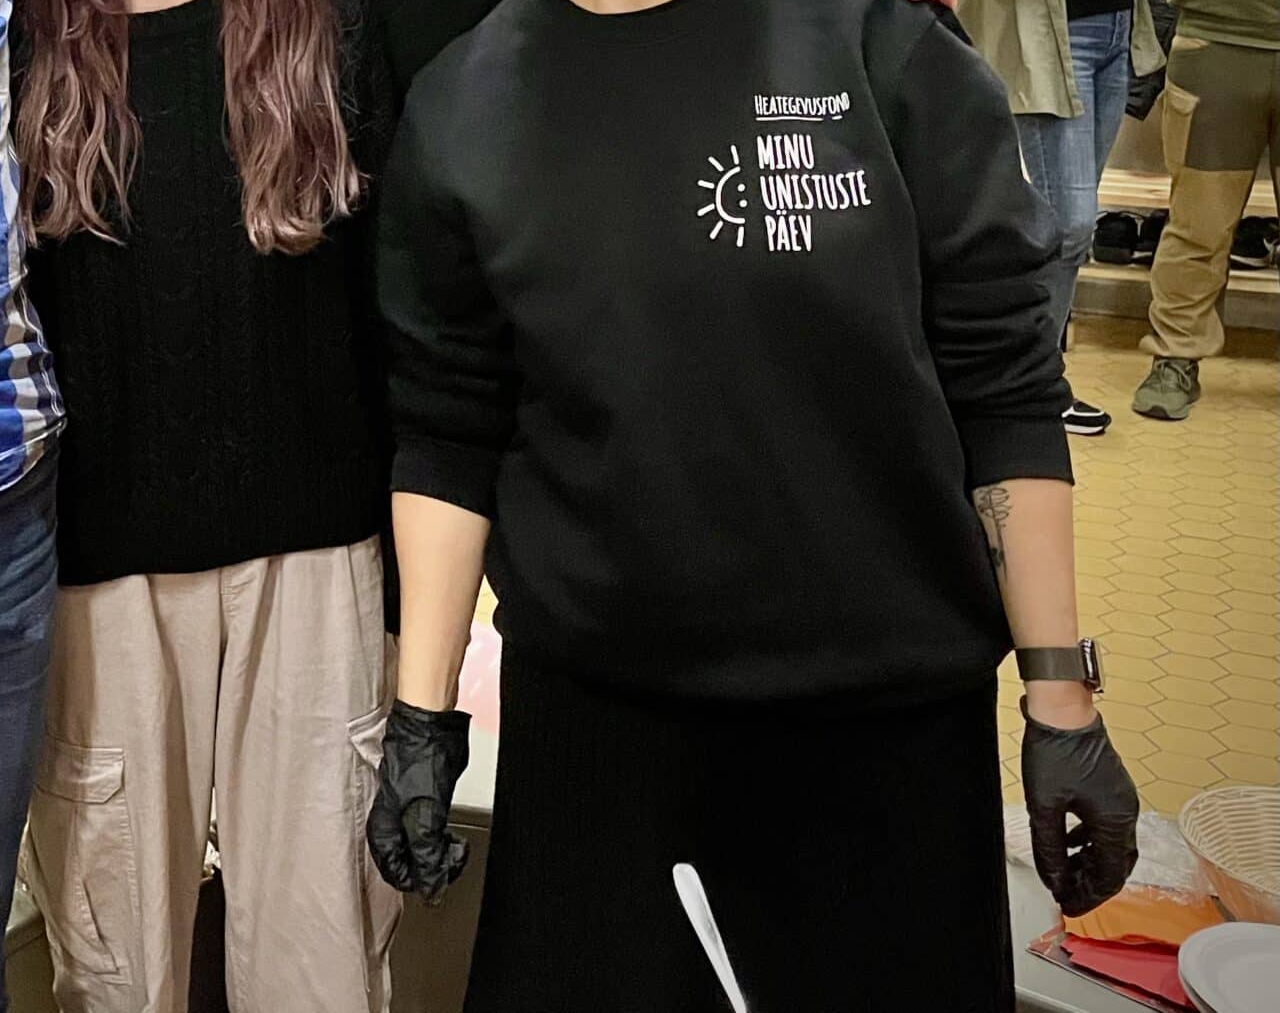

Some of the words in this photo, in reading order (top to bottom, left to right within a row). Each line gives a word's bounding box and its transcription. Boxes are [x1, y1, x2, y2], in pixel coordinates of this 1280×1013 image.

[754, 92, 850, 116] HEATEGEVUSFOND
[756, 133, 815, 171] MINU
[759, 170, 871, 210] UNISTUSTE
[764, 208, 812, 252] PÄEV
